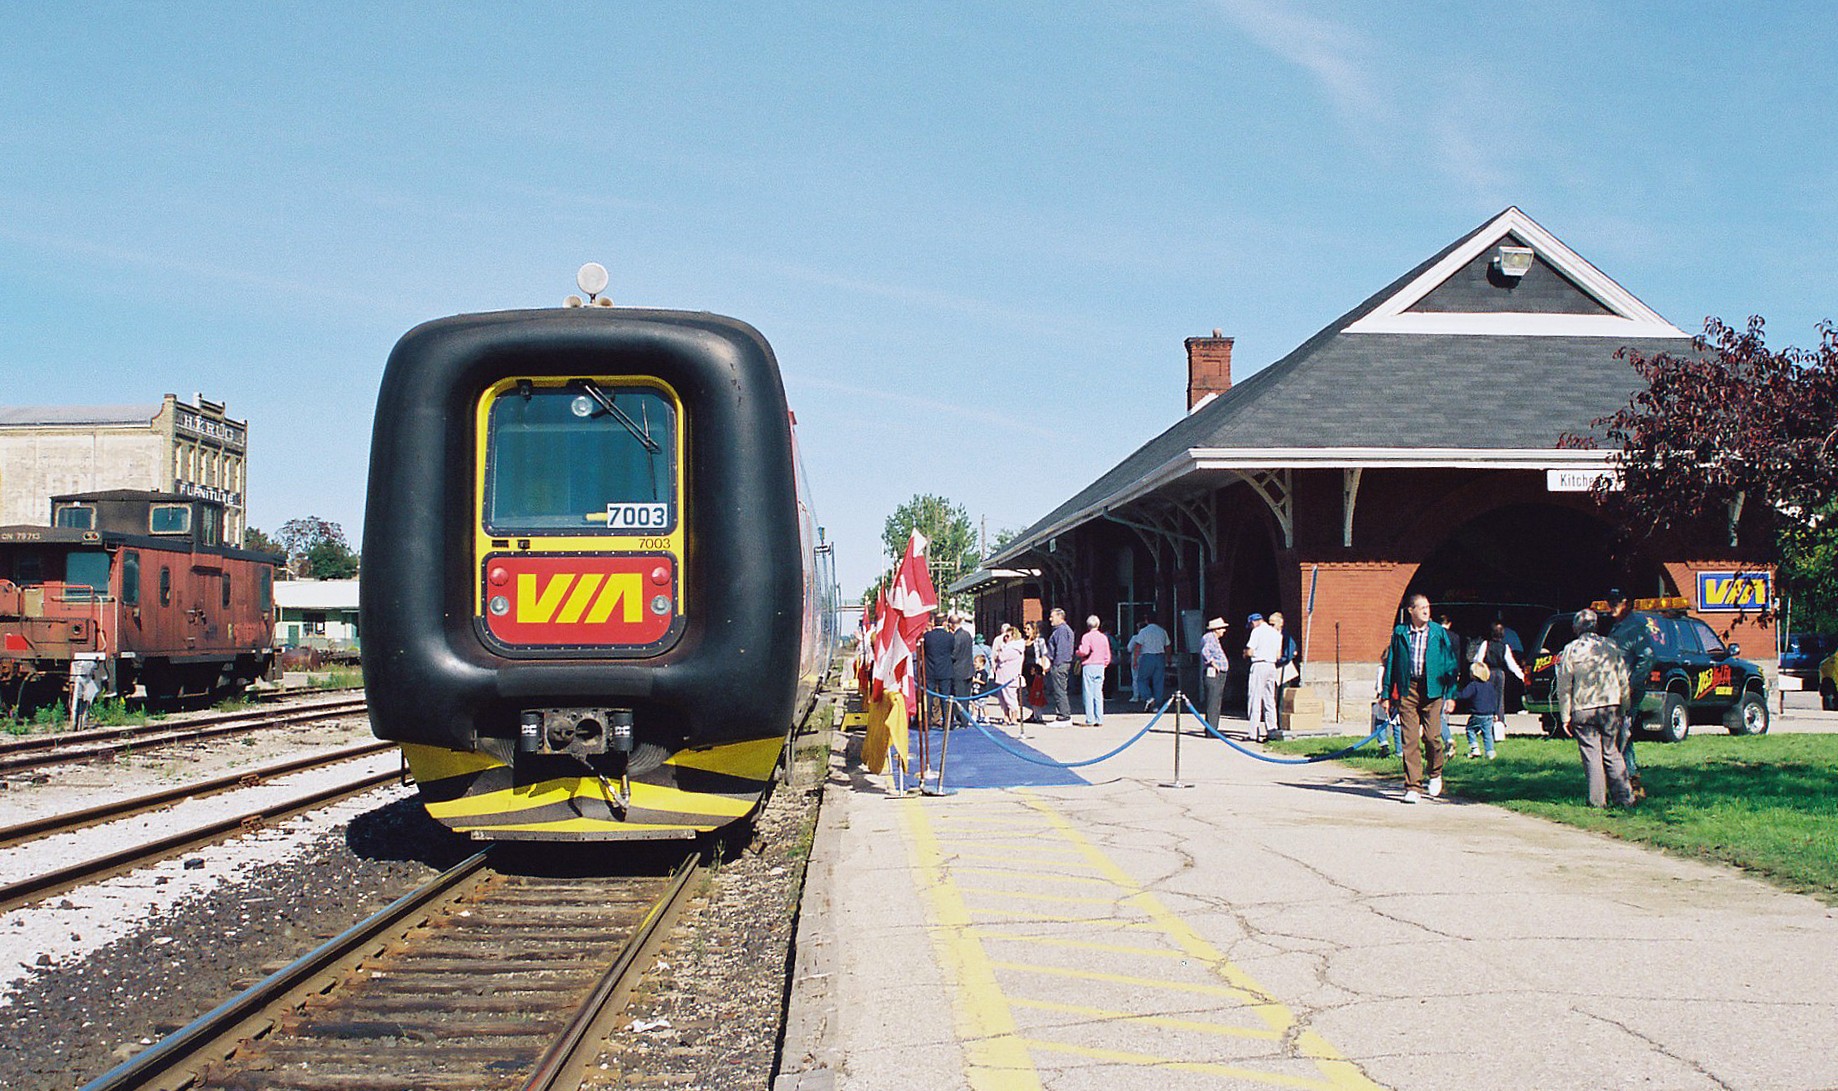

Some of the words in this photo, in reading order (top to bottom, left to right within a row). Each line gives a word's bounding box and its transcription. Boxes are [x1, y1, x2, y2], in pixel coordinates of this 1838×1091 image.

[1560, 474, 1607, 487] Kitche
[180, 484, 235, 505] FURNITURE
[609, 507, 665, 526] 7003
[639, 538, 671, 549] 7003
[517, 573, 643, 624] VIA
[1705, 578, 1766, 605] VIA
